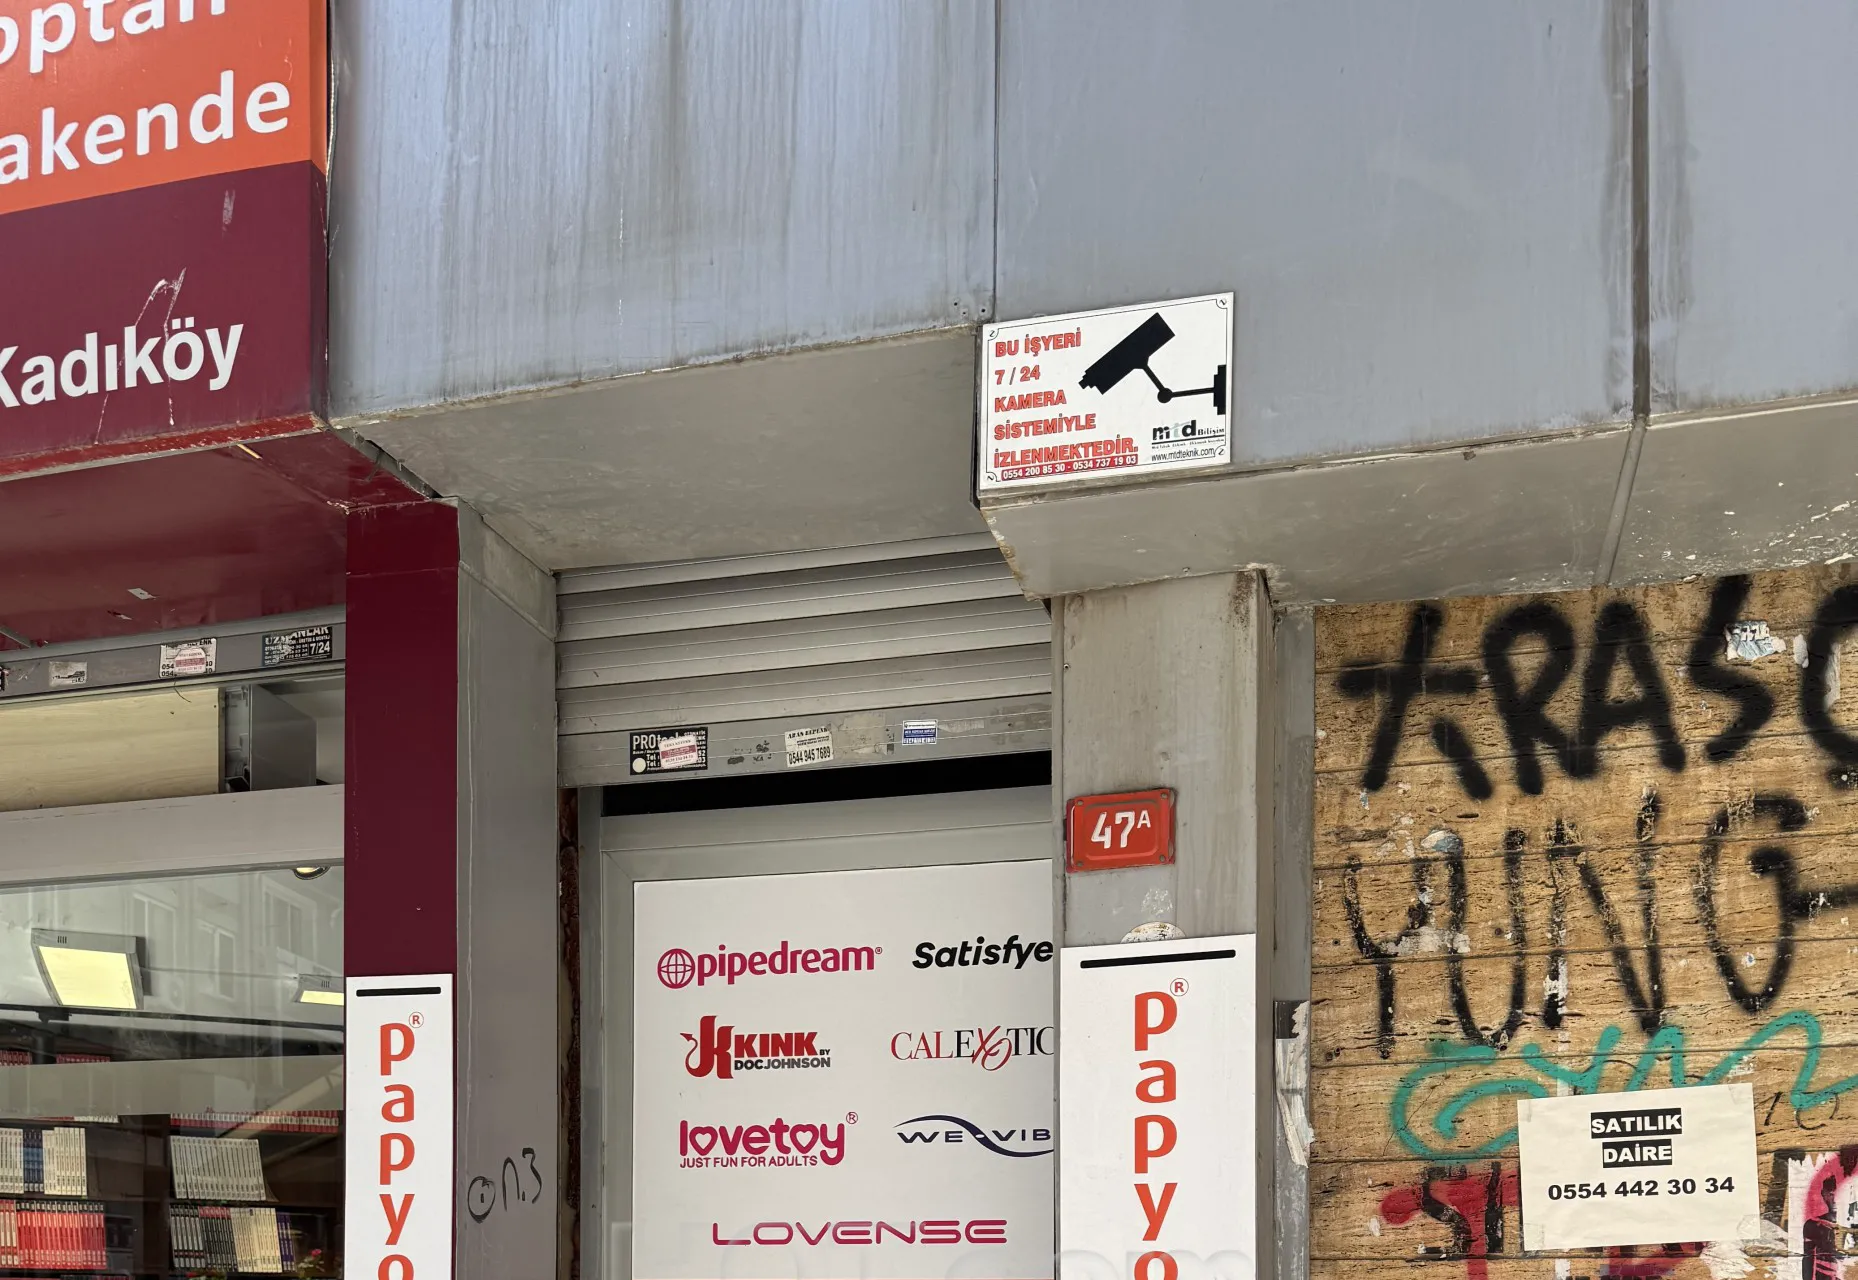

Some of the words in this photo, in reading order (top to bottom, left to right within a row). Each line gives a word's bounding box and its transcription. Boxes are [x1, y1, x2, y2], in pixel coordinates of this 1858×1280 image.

[995, 340, 1019, 357] BU
[1025, 327, 1081, 356] İŞYERİ
[994, 390, 1066, 412] KAMERA
[994, 413, 1096, 440] SİSTEMİYLE
[994, 434, 1138, 468] İZLENMEKTEDİR.
[1003, 468, 1023, 480] 0554
[1025, 466, 1041, 477] 200
[1042, 465, 1053, 475] 85
[1054, 463, 1065, 474] 30
[1073, 460, 1093, 471] 0534
[1096, 458, 1111, 469] 737
[1114, 457, 1124, 467] 19
[1126, 455, 1136, 466] 03
[310, 641, 330, 654] 7/24
[789, 750, 803, 765] 0544
[804, 748, 815, 762] 945
[698, 940, 875, 986] pipedream
[912, 935, 1054, 969] Satisfye
[734, 1032, 819, 1057] KINK
[1591, 1114, 1682, 1134] SATILIK
[680, 1118, 845, 1166] lovetoy
[1603, 1144, 1672, 1164] DAİRE
[680, 1156, 710, 1169] JUST
[714, 1156, 738, 1168] FUN
[741, 1156, 767, 1168] FOR
[769, 1155, 818, 1168] ADULTS
[1548, 1182, 1607, 1201] 0554
[1615, 1180, 1659, 1198] 442
[1667, 1178, 1697, 1196] 30
[1705, 1176, 1735, 1194] 34
[712, 1219, 1008, 1246] LOVENSE
